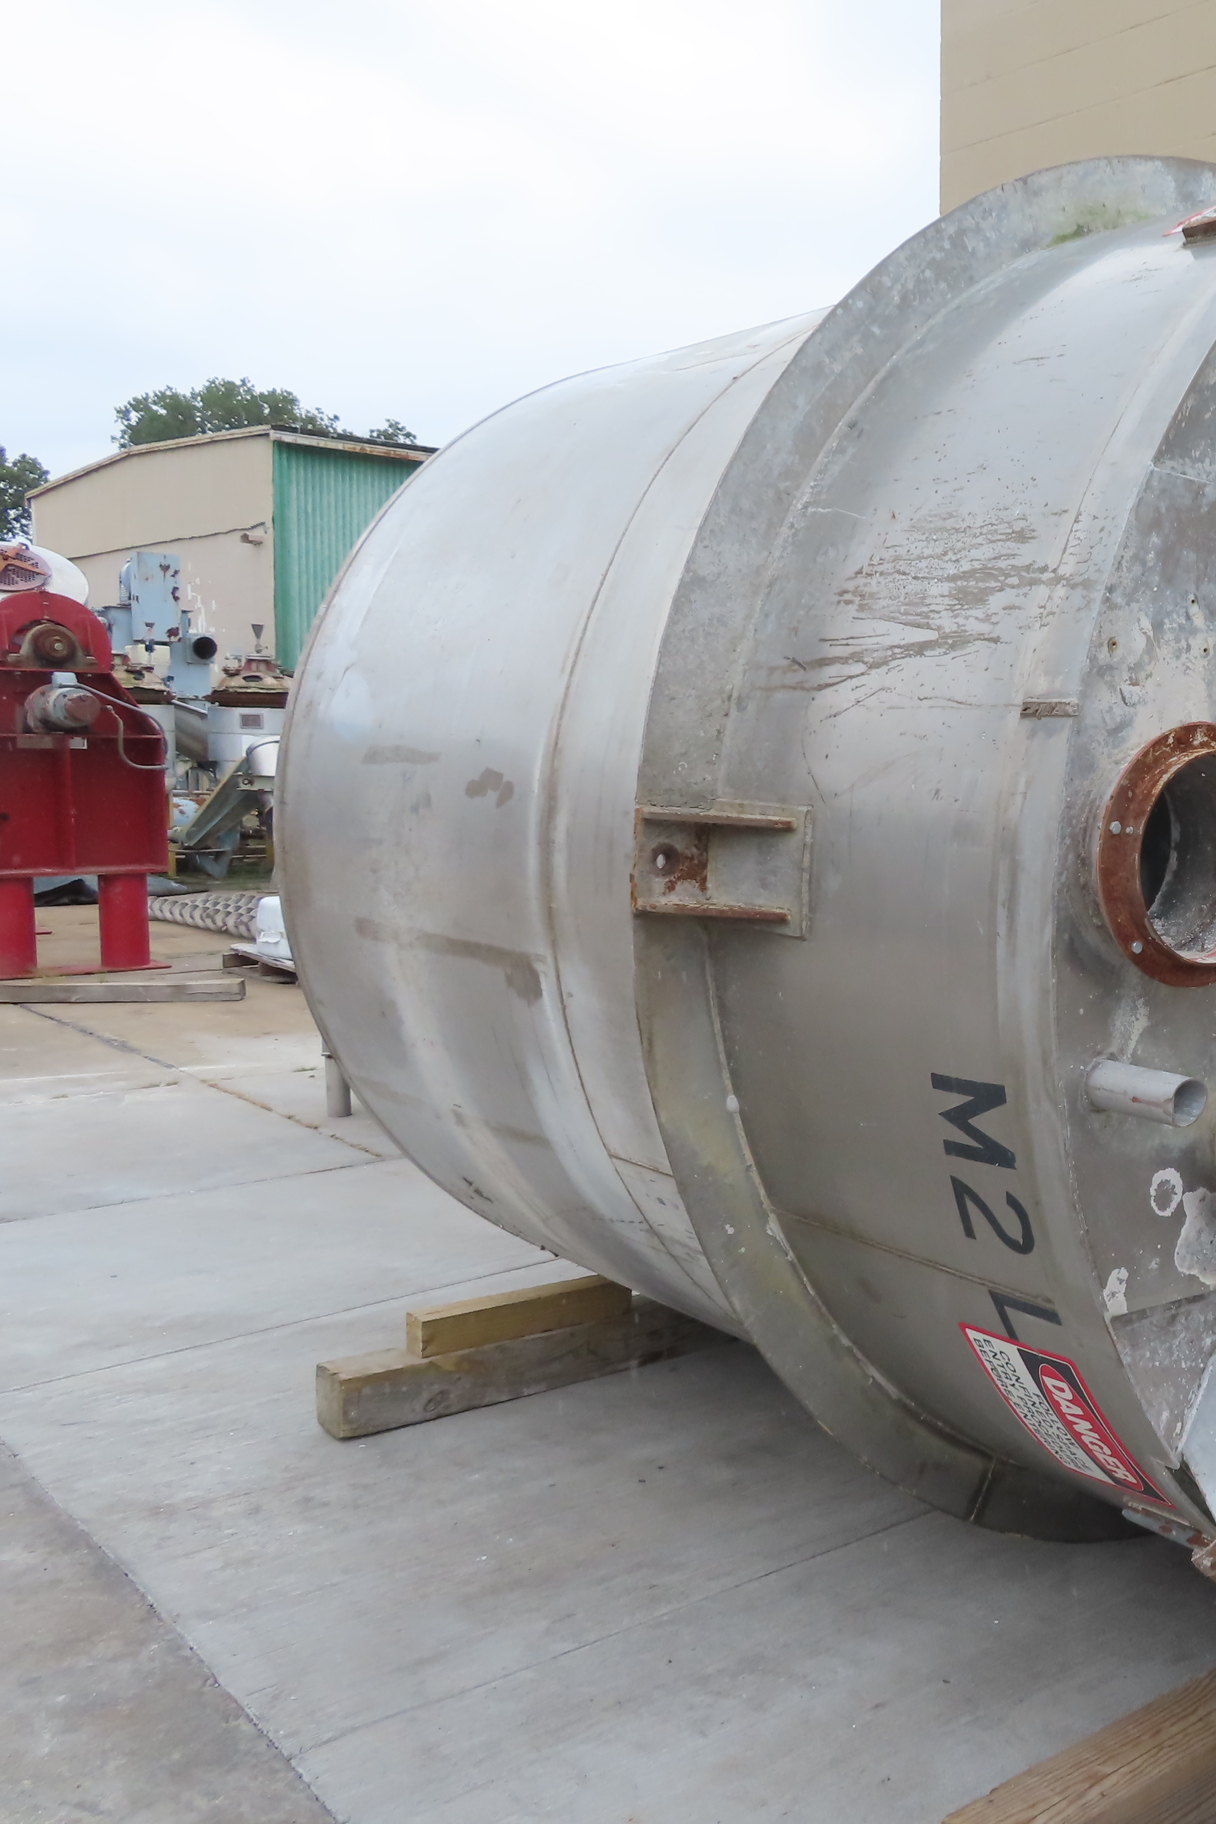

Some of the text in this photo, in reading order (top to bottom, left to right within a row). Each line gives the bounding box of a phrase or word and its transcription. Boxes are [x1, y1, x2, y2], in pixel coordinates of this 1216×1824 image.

[972, 1337, 1071, 1466] BEFORE ENTERING
[982, 1338, 1021, 1392] ENTRY
[999, 1350, 1094, 1472] CONFINED SPACE
[1031, 1391, 1080, 1450] FOLLOW
[1041, 1374, 1138, 1484] DANGER
